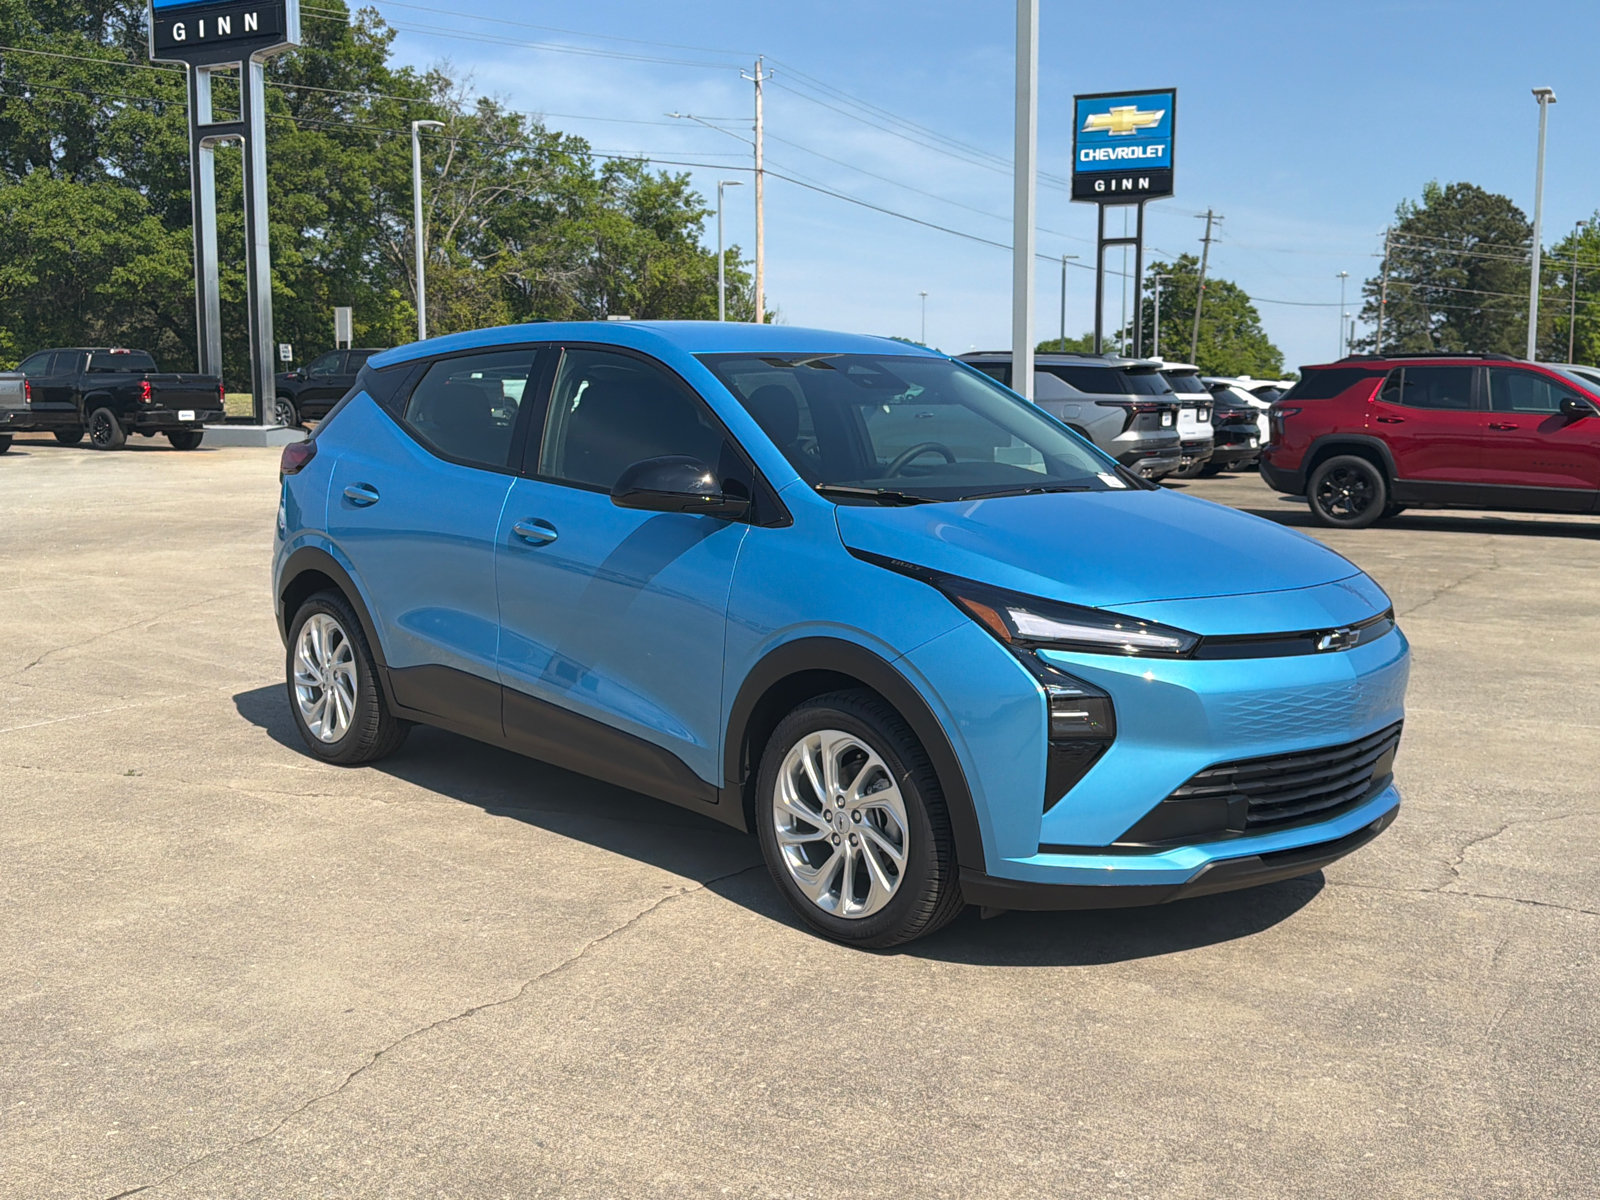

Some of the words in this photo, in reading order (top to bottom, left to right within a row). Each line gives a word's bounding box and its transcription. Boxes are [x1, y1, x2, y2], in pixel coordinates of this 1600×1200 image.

[172, 12, 258, 42] GINN
[1080, 145, 1165, 162] CHEVROLET
[1094, 177, 1150, 192] GINN
